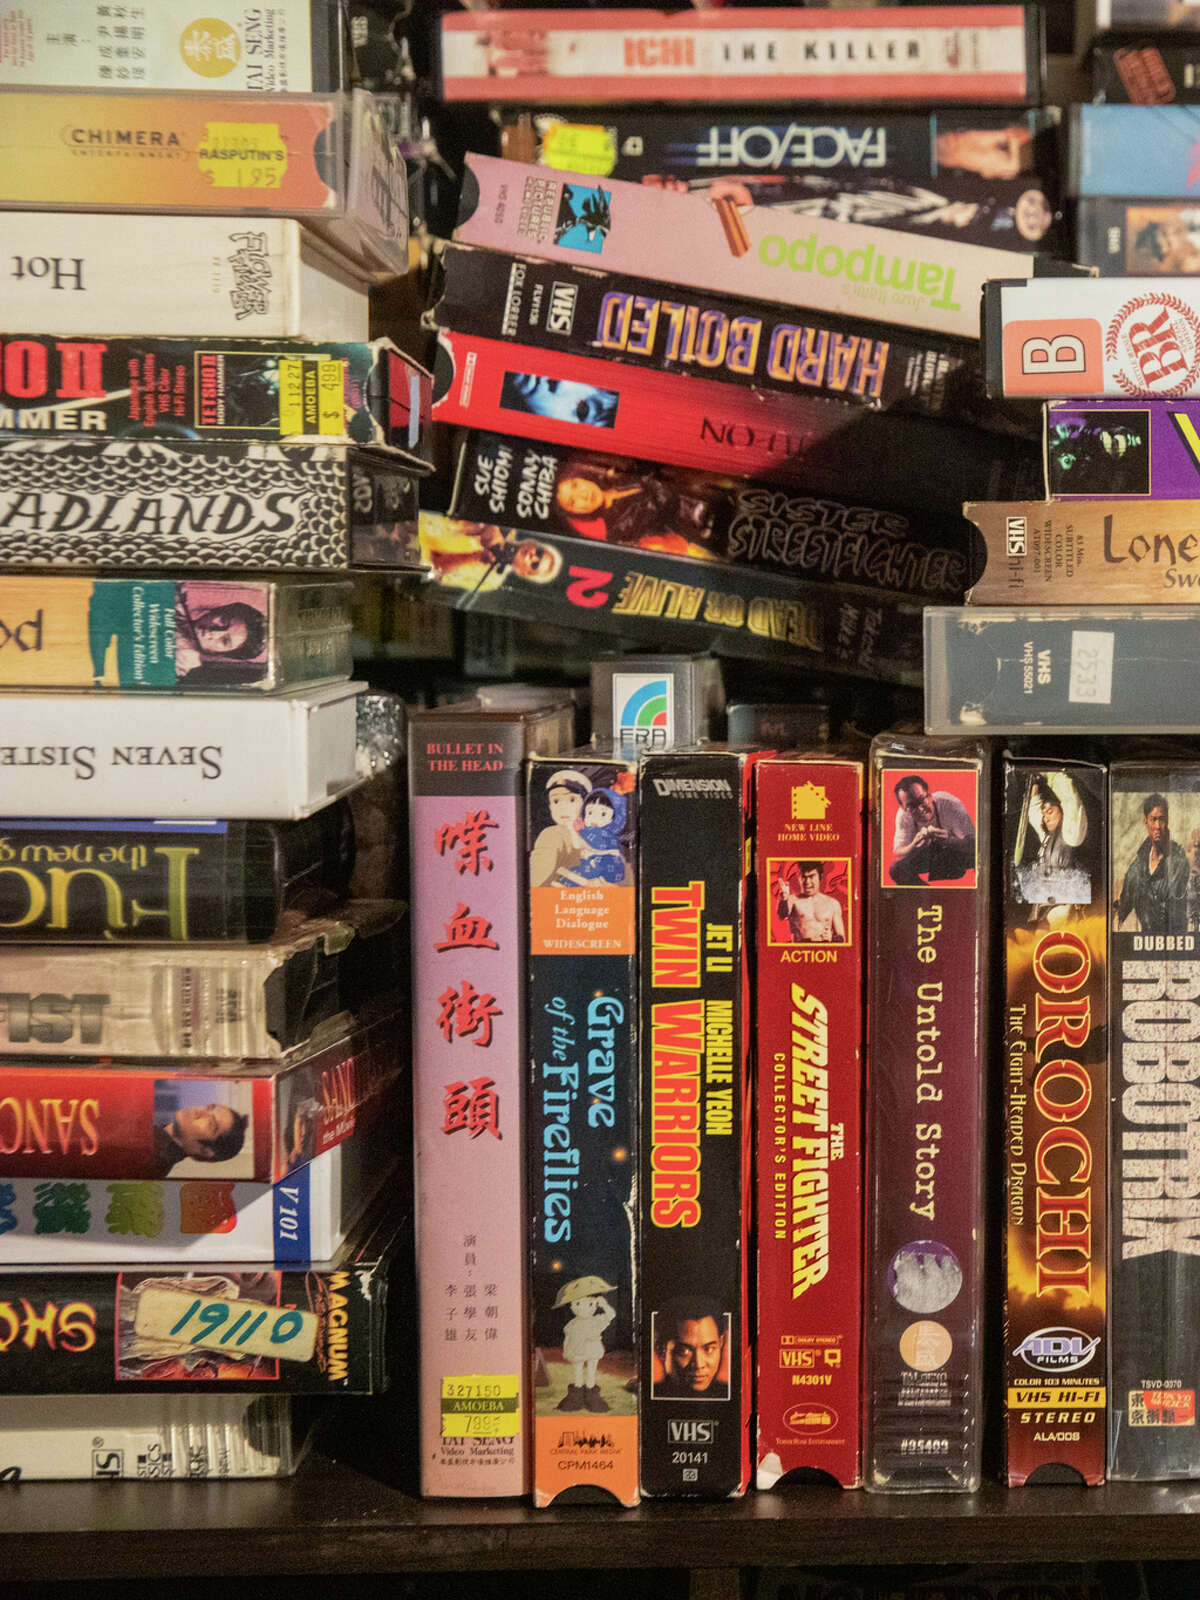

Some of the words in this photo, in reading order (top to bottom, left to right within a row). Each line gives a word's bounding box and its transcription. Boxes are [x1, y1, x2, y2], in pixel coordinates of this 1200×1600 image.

[246, 9, 263, 56] SENG
[624, 37, 694, 66] ICHI
[723, 41, 778, 61] THE
[805, 38, 920, 60] KILLER
[71, 128, 180, 147] CHIMERA
[200, 148, 285, 161] RASPUTIN'S
[698, 125, 886, 167] FACE/OFF
[12, 254, 85, 291] Hot
[760, 234, 961, 311] Tampopo
[596, 291, 763, 375] BOILED
[144, 352, 155, 392] Subtitles
[767, 323, 890, 397] HARD
[1022, 334, 1086, 375] B
[217, 354, 225, 397] HAMMER
[143, 394, 156, 428] English
[201, 368, 218, 425] TETSUO
[217, 398, 225, 425] BODY
[304, 369, 318, 424] AMOEBA
[516, 450, 541, 519] SONNY
[535, 454, 557, 519] CHIBA
[1065, 524, 1074, 578] SUBTITLED
[1103, 514, 1199, 565] Lone
[149, 603, 160, 665] Widescreen
[1037, 649, 1051, 685] VHS
[112, 747, 222, 780] SEVEN
[426, 743, 484, 755] BULLET
[488, 743, 503, 755] IN
[429, 760, 458, 772] THE
[462, 760, 503, 772] HEAD
[653, 778, 732, 795] DIMENSION
[19, 843, 93, 868] new
[778, 833, 807, 842] HOME
[809, 833, 840, 842] VIDEO
[98, 845, 148, 871] the
[554, 904, 610, 917] Language
[560, 889, 605, 902] English
[556, 917, 609, 930] Dialogue
[650, 880, 706, 989] TWIN
[705, 922, 734, 953] JET
[916, 904, 944, 963] The
[543, 939, 622, 949] WIDESCREEN
[780, 950, 838, 964] ACTION
[1133, 935, 1195, 952] DUBBED
[705, 956, 734, 972] LI
[543, 995, 576, 1028] of
[551, 1026, 577, 1062] the
[705, 998, 734, 1084] MICHELLE
[791, 982, 829, 1131] STREET
[916, 982, 944, 1105] Untold
[586, 995, 625, 1129] Grave
[650, 998, 706, 1229] WARRIORS
[705, 1087, 734, 1136] YEOH
[773, 1052, 786, 1165] COLLECTOR'S
[1032, 931, 1093, 1298] OROCHI
[542, 1062, 580, 1244] Fireflies
[831, 1122, 845, 1161] THE
[909, 1122, 944, 1221] Story
[278, 1186, 299, 1204] V
[774, 1172, 787, 1241] EDITION
[279, 1210, 299, 1241] 101
[791, 1134, 829, 1299] FIGHTER
[328, 1271, 349, 1382] MAGNUM
[782, 1350, 812, 1367] VHS
[1036, 1355, 1078, 1363] FILMS
[446, 1383, 502, 1398] 327150
[452, 1401, 505, 1411] AMOEBA
[1016, 1390, 1051, 1403] VHS
[1057, 1390, 1100, 1402] HI-FI
[669, 1421, 713, 1443] VHS
[1020, 1411, 1097, 1424] STEREO
[441, 1447, 465, 1456] Video
[469, 1447, 515, 1457] Marketing
[671, 1451, 709, 1464] 20141
